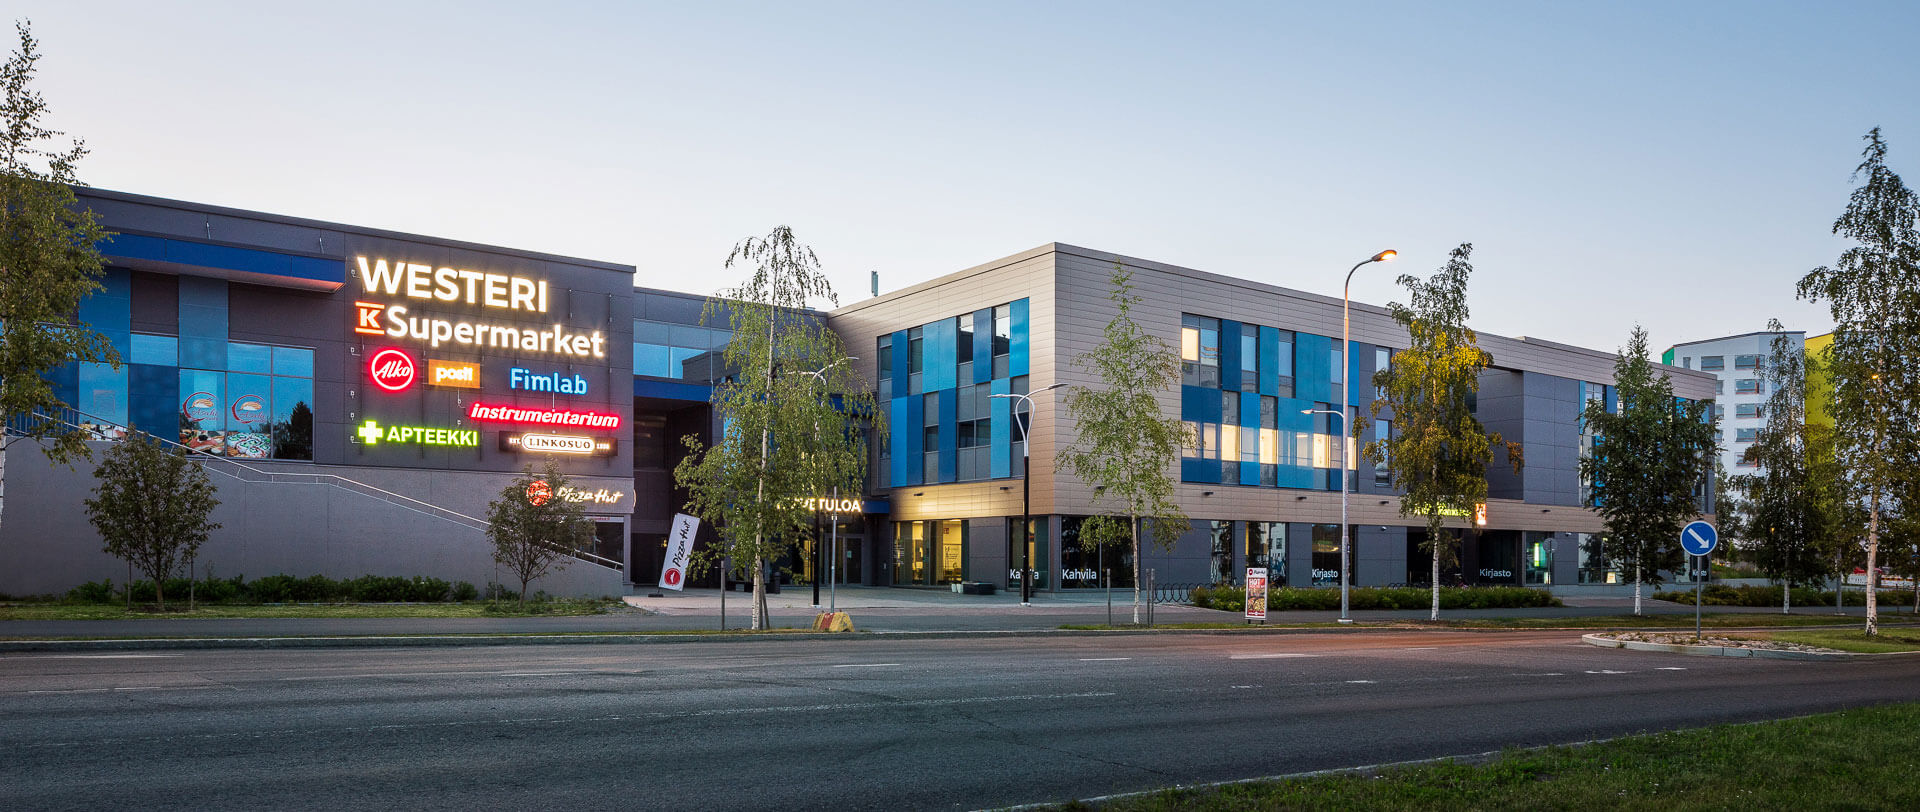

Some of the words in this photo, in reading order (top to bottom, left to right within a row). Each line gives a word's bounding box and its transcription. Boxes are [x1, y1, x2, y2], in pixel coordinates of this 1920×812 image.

[357, 256, 548, 313] WESTERI
[360, 308, 381, 328] K
[386, 305, 605, 357] Supermarket
[375, 360, 412, 379] Alko
[436, 366, 473, 382] posti
[510, 367, 588, 395] Fimlab
[471, 404, 620, 428] instrumentarium
[386, 425, 478, 447] APTEEKKI
[528, 437, 591, 449] LINKOSUO
[593, 489, 624, 503] Hut
[672, 540, 686, 567] Pizza
[679, 519, 691, 540] Hut
[1062, 568, 1097, 580] Kahvila
[1312, 568, 1339, 580] Kirjasto
[1480, 568, 1512, 579] Kirjasto
